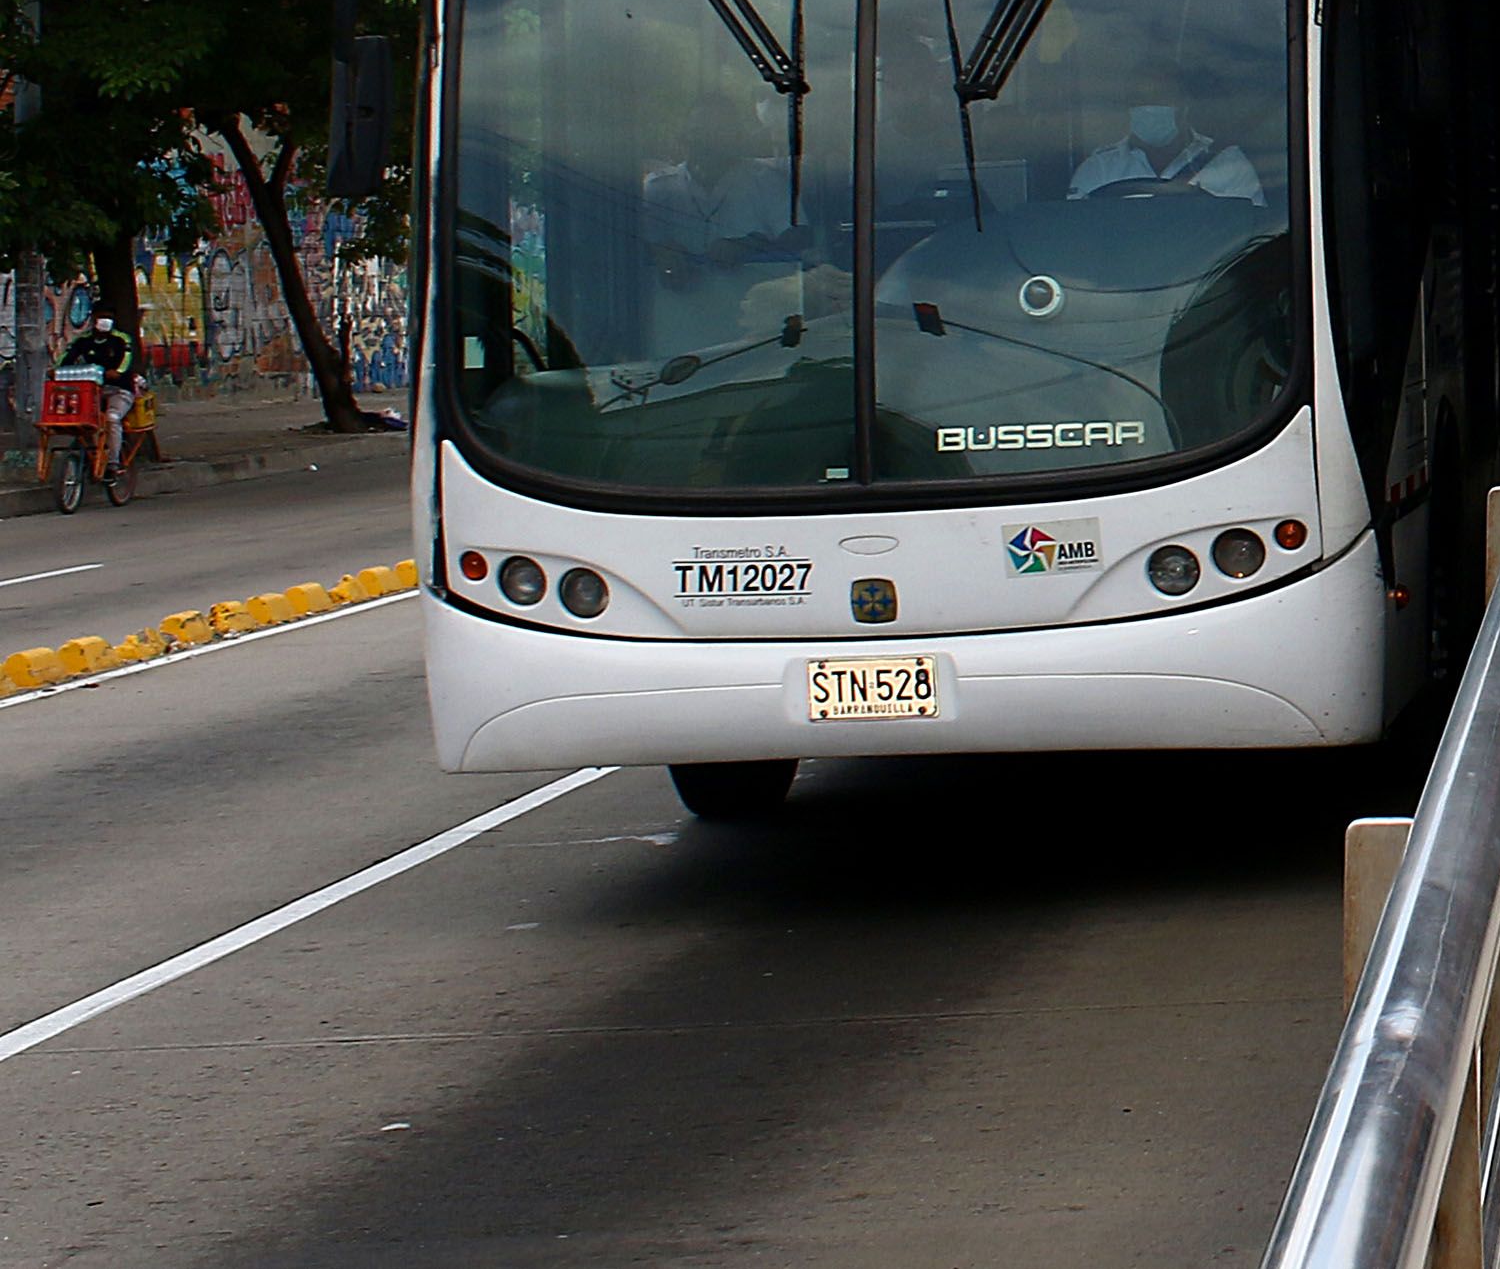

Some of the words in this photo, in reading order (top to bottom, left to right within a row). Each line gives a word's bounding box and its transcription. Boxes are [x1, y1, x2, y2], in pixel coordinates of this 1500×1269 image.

[937, 420, 1145, 452] BUSSCAR
[692, 546, 761, 559] Transmetro
[764, 545, 790, 558] S.A.
[1058, 541, 1095, 559] AMB
[675, 563, 813, 593] TM12027
